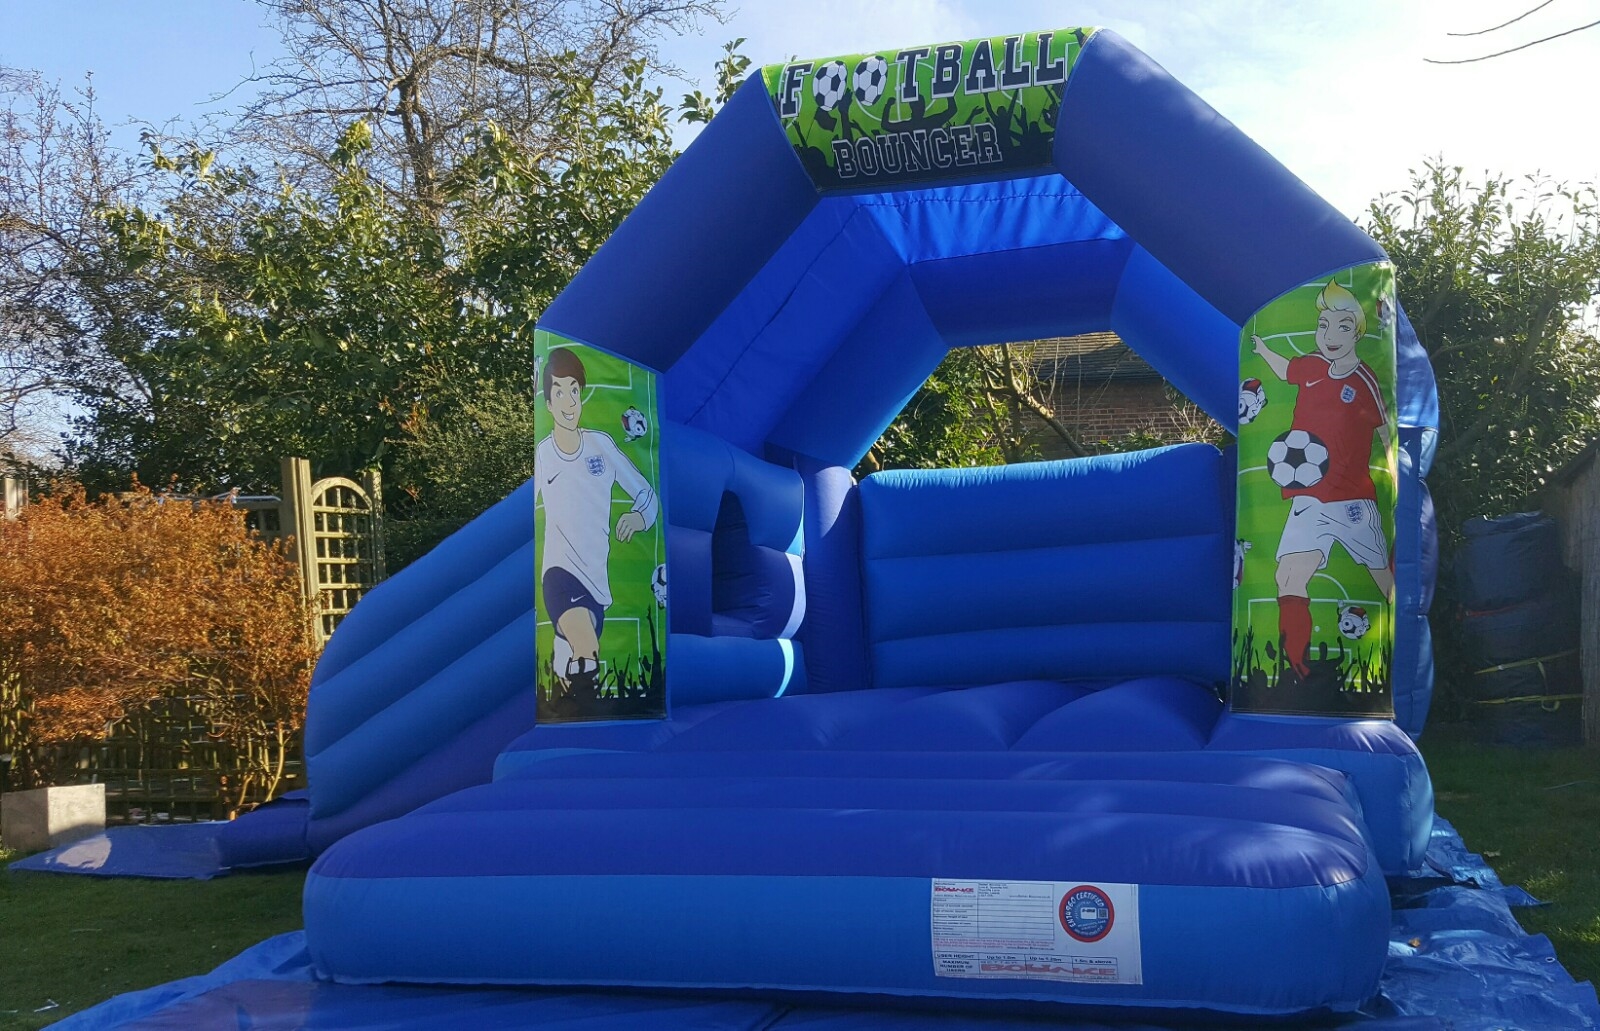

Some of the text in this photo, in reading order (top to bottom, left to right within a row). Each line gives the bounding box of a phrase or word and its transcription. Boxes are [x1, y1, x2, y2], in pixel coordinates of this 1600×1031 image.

[780, 31, 1066, 119] FOOTBALL
[831, 122, 1003, 179] BOUNCER
[1076, 891, 1105, 907] CERTIFIED
